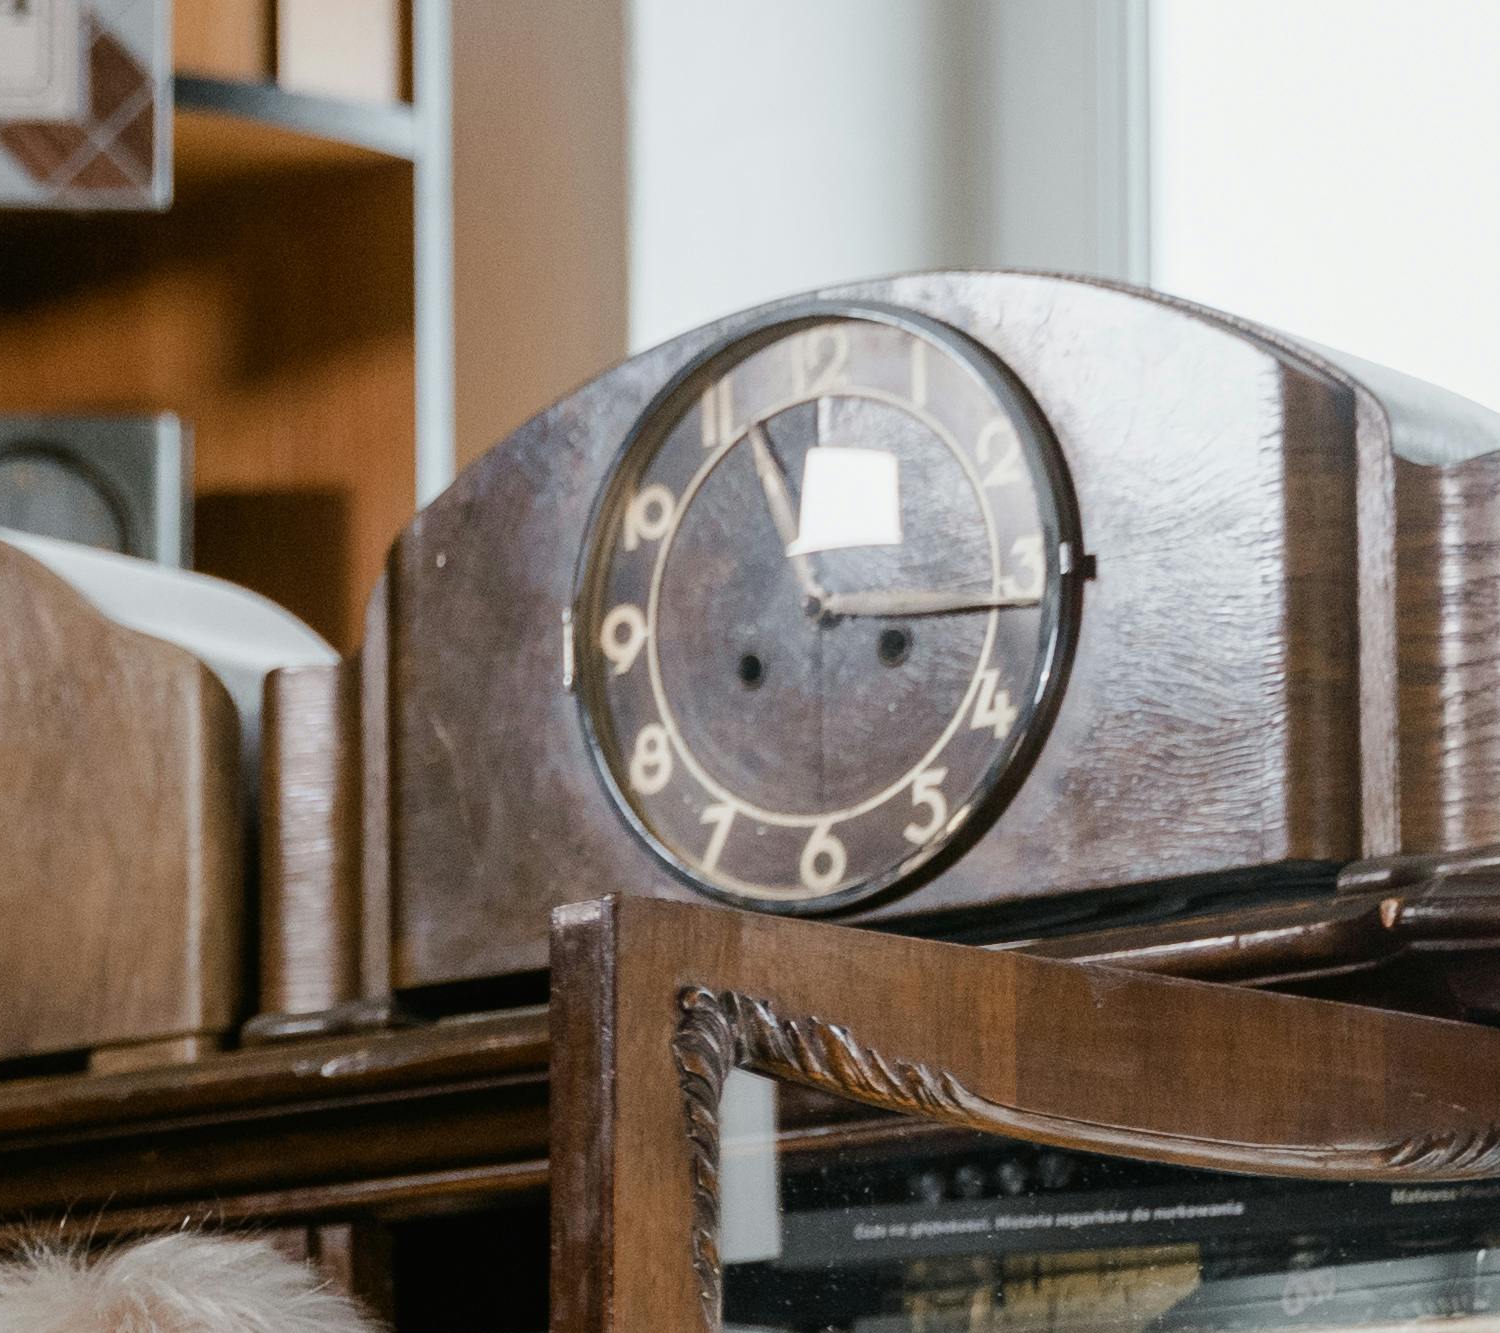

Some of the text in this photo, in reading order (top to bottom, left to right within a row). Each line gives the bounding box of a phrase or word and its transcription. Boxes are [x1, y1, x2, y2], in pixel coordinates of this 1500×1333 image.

[702, 373, 735, 449] 11
[976, 421, 1023, 488] 2
[622, 483, 677, 552] 10
[1003, 534, 1046, 598] 3
[599, 603, 646, 676] 9
[969, 669, 1018, 740] 4
[629, 722, 674, 796] 8
[699, 803, 741, 874] 7
[903, 767, 951, 845] 5
[799, 821, 848, 892] 6
